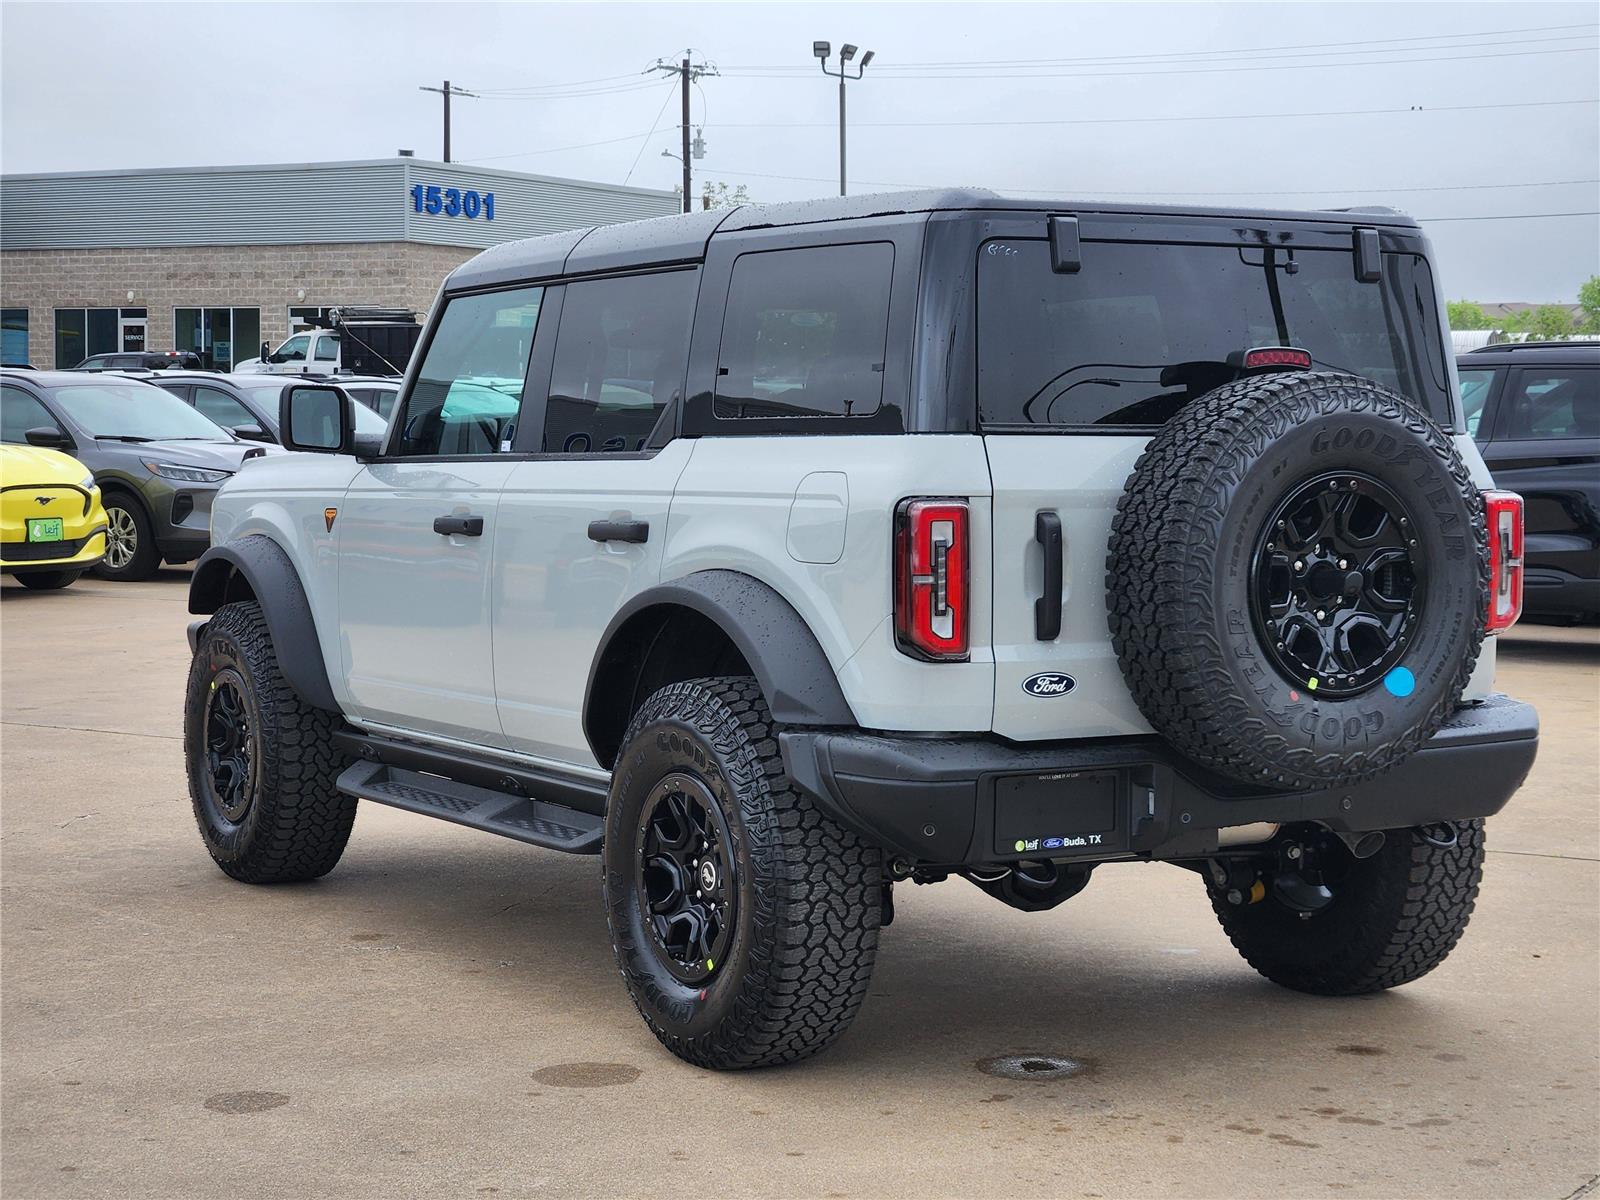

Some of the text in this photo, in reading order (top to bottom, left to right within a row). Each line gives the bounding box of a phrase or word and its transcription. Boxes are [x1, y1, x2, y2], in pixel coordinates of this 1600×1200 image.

[409, 184, 496, 221] 15301
[1033, 676, 1068, 693] Ford
[1063, 837, 1087, 847] Buda,
[1088, 834, 1102, 843] TX
